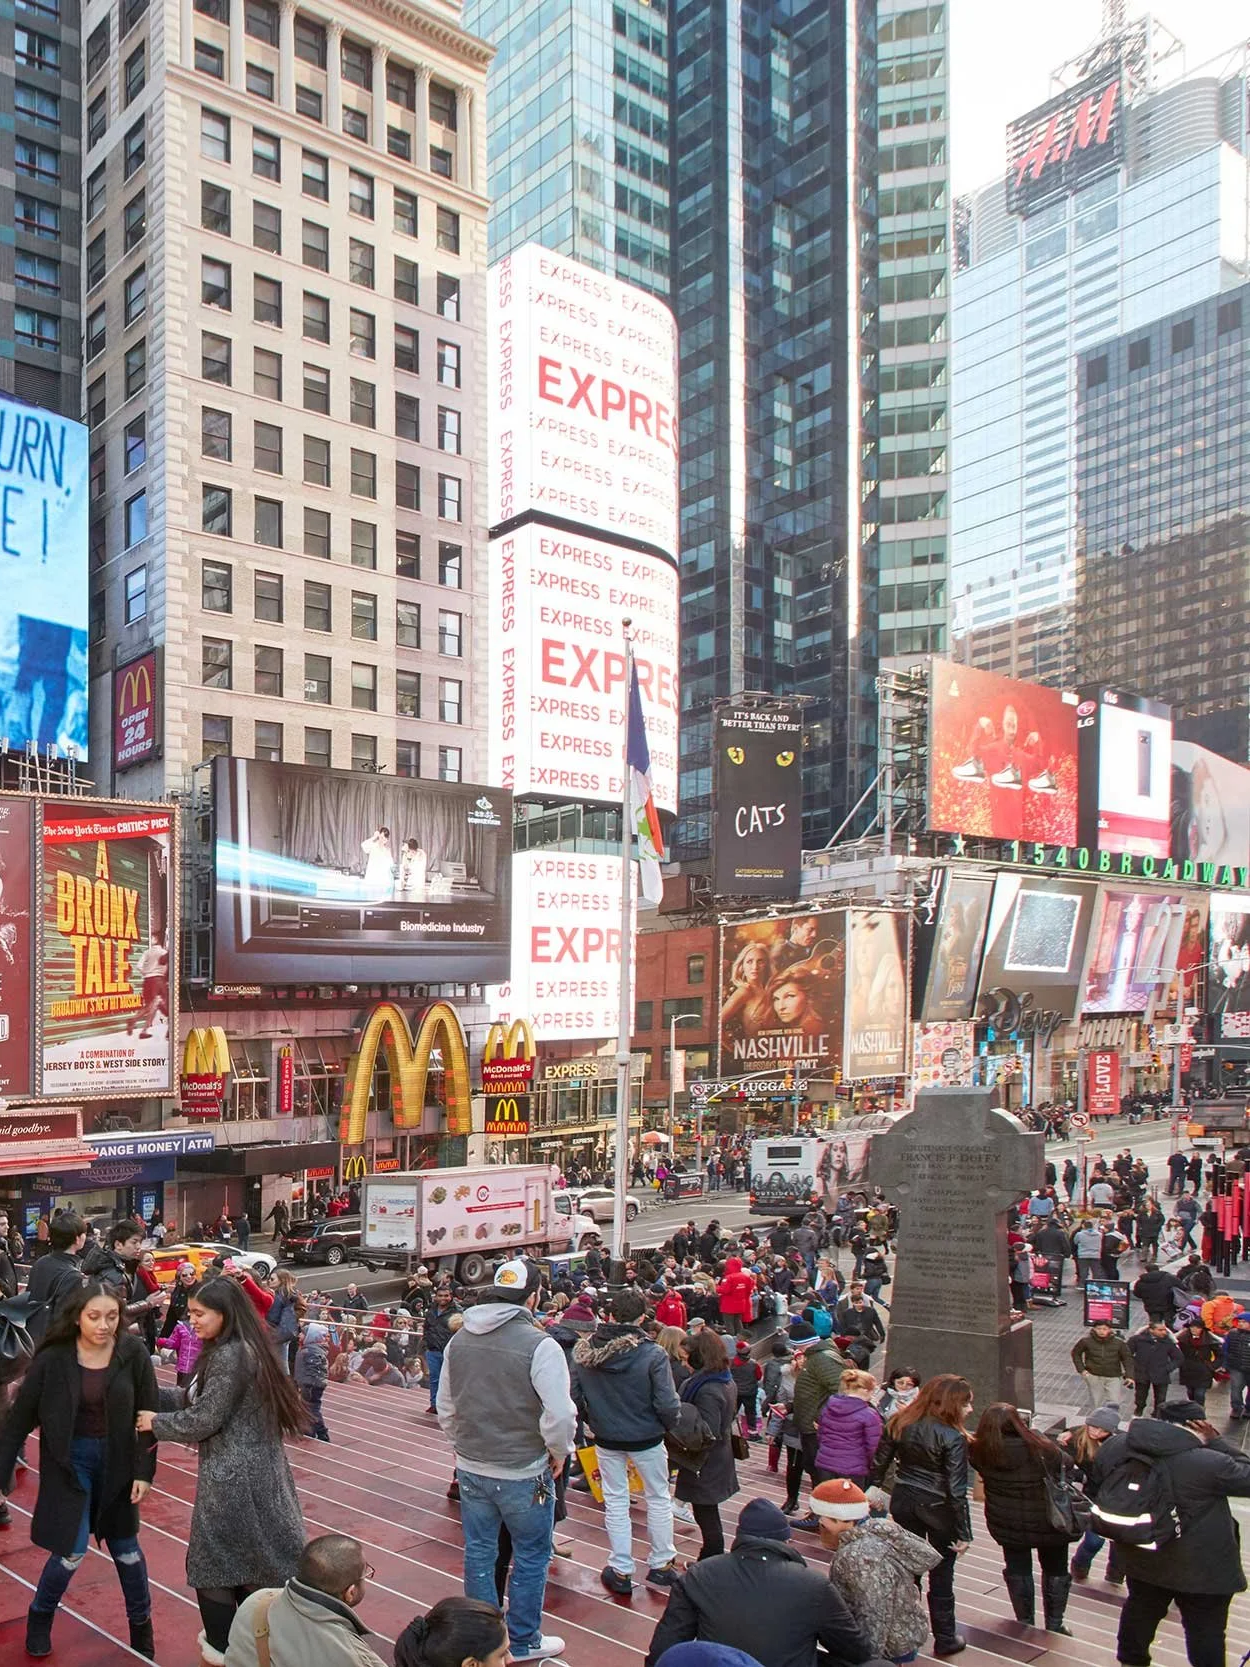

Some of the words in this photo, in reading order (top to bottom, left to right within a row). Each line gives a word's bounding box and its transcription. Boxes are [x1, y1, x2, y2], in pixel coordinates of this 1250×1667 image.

[540, 259, 612, 302] EXPRESS
[533, 289, 598, 328] XPRESS
[540, 326, 612, 367] EXPRESS
[500, 320, 512, 410] EXPRESS
[534, 415, 598, 449] XPRESS
[500, 429, 514, 521] EXPRESS
[541, 451, 613, 487] EXPRESS
[536, 486, 598, 517] XPRESS
[540, 538, 613, 572] EXPRESS
[501, 539, 515, 633] EXPRESS
[540, 606, 613, 637] EXPRESS
[501, 647, 515, 742] EXPRESS
[121, 708, 149, 728] OPEN
[750, 711, 771, 721] BACK
[772, 714, 789, 723] AND
[753, 721, 777, 730] THAN
[1077, 717, 1095, 729] LG
[124, 721, 146, 746] 24
[540, 732, 613, 757] EXPRESS
[118, 738, 152, 761] HOURS
[43, 826, 57, 836] The
[57, 826, 74, 835] New
[74, 825, 93, 837] York
[93, 823, 116, 834] Times
[151, 817, 170, 829] PICK
[735, 803, 786, 837] CATS
[95, 839, 110, 880] A
[1100, 850, 1249, 888] BROADWAY
[56, 869, 140, 940] BRONX
[537, 892, 610, 911] EXPRESS
[400, 920, 451, 933] Biomedicine
[452, 922, 485, 936] Industry
[69, 934, 133, 996] TALE
[536, 981, 608, 998] EXPRESS
[85, 1049, 127, 1059] COMBINATION
[127, 1048, 135, 1057] OF
[733, 1034, 830, 1060] NASHVILLE
[851, 1031, 903, 1054] NASHVILLE
[43, 1061, 72, 1071] JERSEY
[74, 1060, 95, 1070] BOYS
[95, 1060, 101, 1069] &
[103, 1059, 124, 1069] WEST
[124, 1058, 142, 1068] SIDE
[483, 1064, 532, 1075] McDonald's
[545, 1062, 599, 1079] EXPRESS
[182, 1081, 223, 1092] McDonald's
[137, 1141, 181, 1154] MONEY
[187, 1138, 213, 1150] ATM
